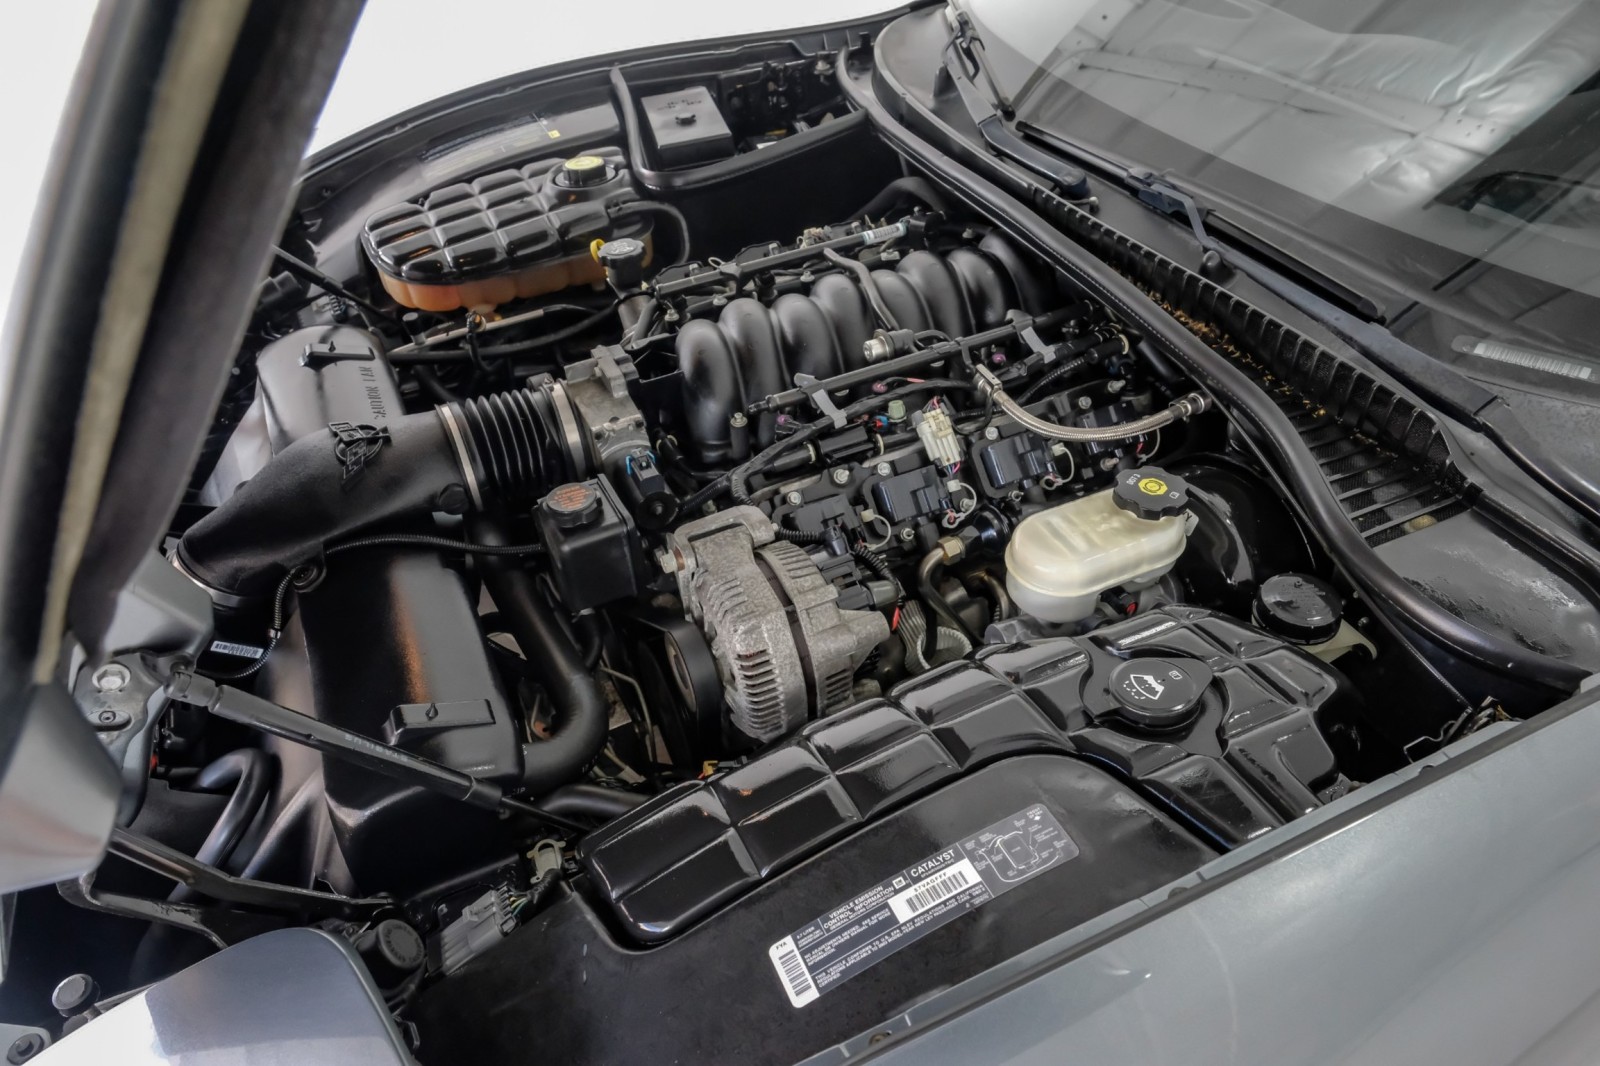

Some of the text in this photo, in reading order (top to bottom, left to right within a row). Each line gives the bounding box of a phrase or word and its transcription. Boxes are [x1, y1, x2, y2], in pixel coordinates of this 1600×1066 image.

[344, 733, 408, 762] STABILUS
[911, 849, 954, 877] CATALYST
[824, 887, 894, 928] CONTROL INFORMATION
[829, 886, 883, 918] VEHICLE EMISSION
[830, 892, 894, 930] GENERAL MOTORS CORPORATION
[803, 927, 814, 935] LITER
[806, 951, 823, 962] MANUAL
[851, 925, 868, 936] MANUAL
[878, 912, 890, 920] MORE
[812, 936, 842, 954] ADJUSTMENTS
[871, 908, 888, 920] SERVICE
[817, 965, 846, 984] REGULATIONS
[846, 950, 871, 966] APPLICABLE
[934, 902, 958, 916] PASSENGER
[827, 960, 846, 973] VEHICLE
[848, 945, 872, 961] CONFORMS
[914, 904, 944, 923] REGULATIONS
[957, 884, 983, 900] CALIFORNIA
